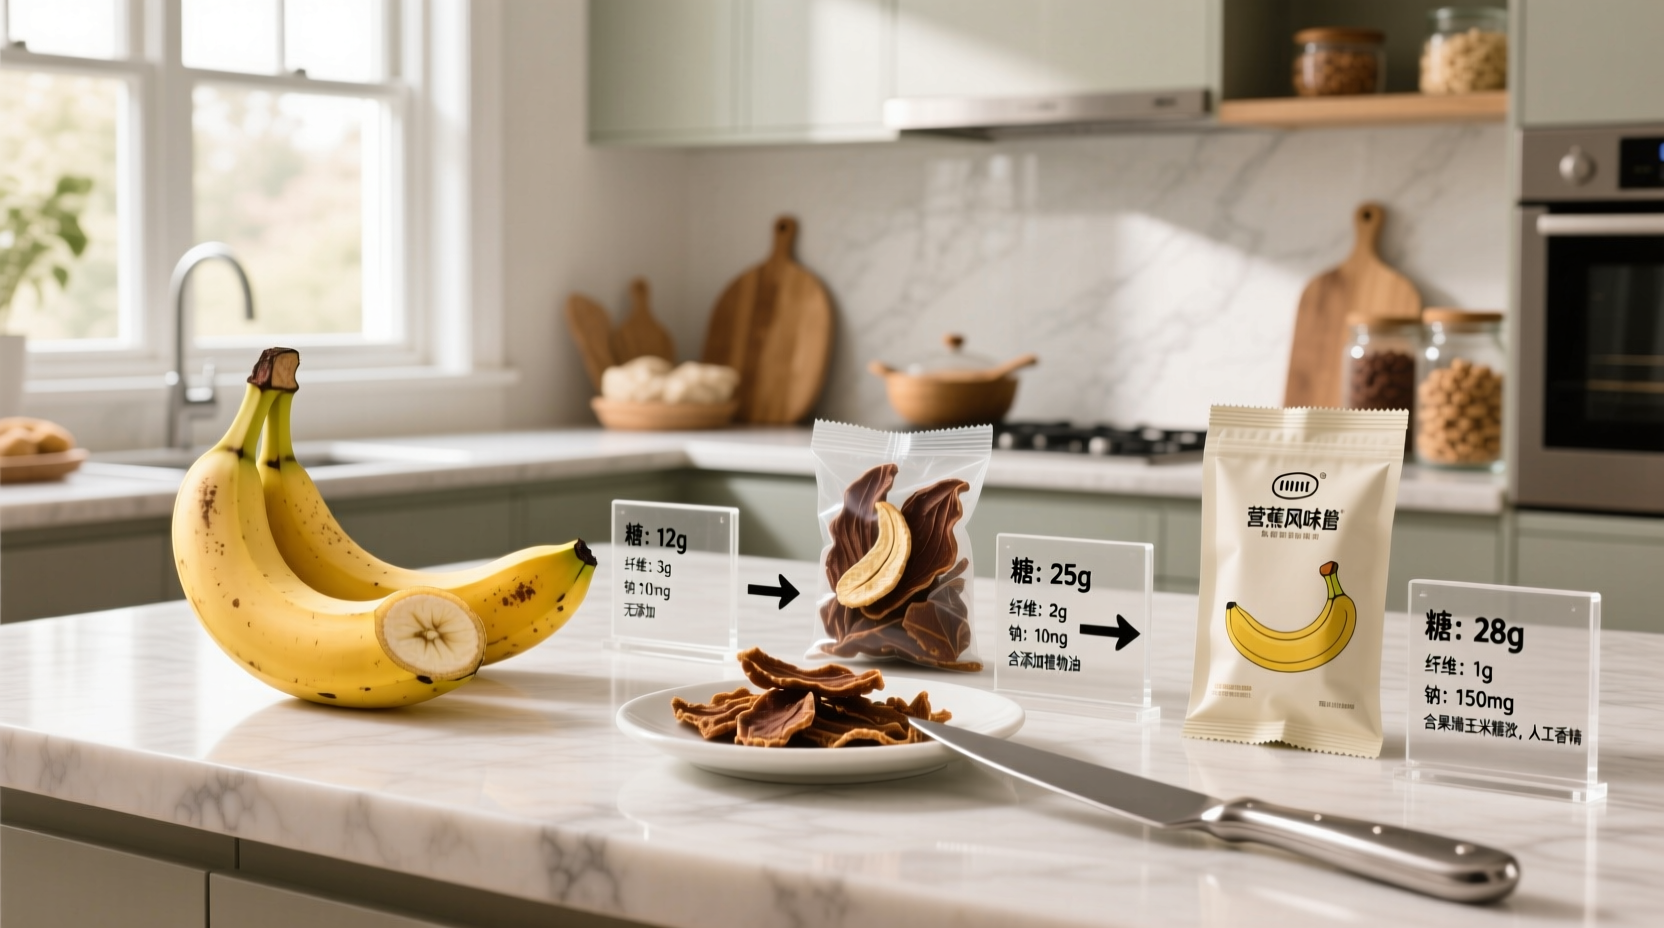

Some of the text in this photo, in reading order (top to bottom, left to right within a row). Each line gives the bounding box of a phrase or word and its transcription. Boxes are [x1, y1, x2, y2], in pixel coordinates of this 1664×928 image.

[656, 527, 688, 555] 12g
[656, 559, 672, 578] 3g
[1050, 562, 1092, 594] 25g
[1049, 603, 1067, 624] 2g
[1473, 616, 1524, 654] 28g
[1473, 660, 1493, 684] 1g
[1456, 688, 1514, 716] 150mg
